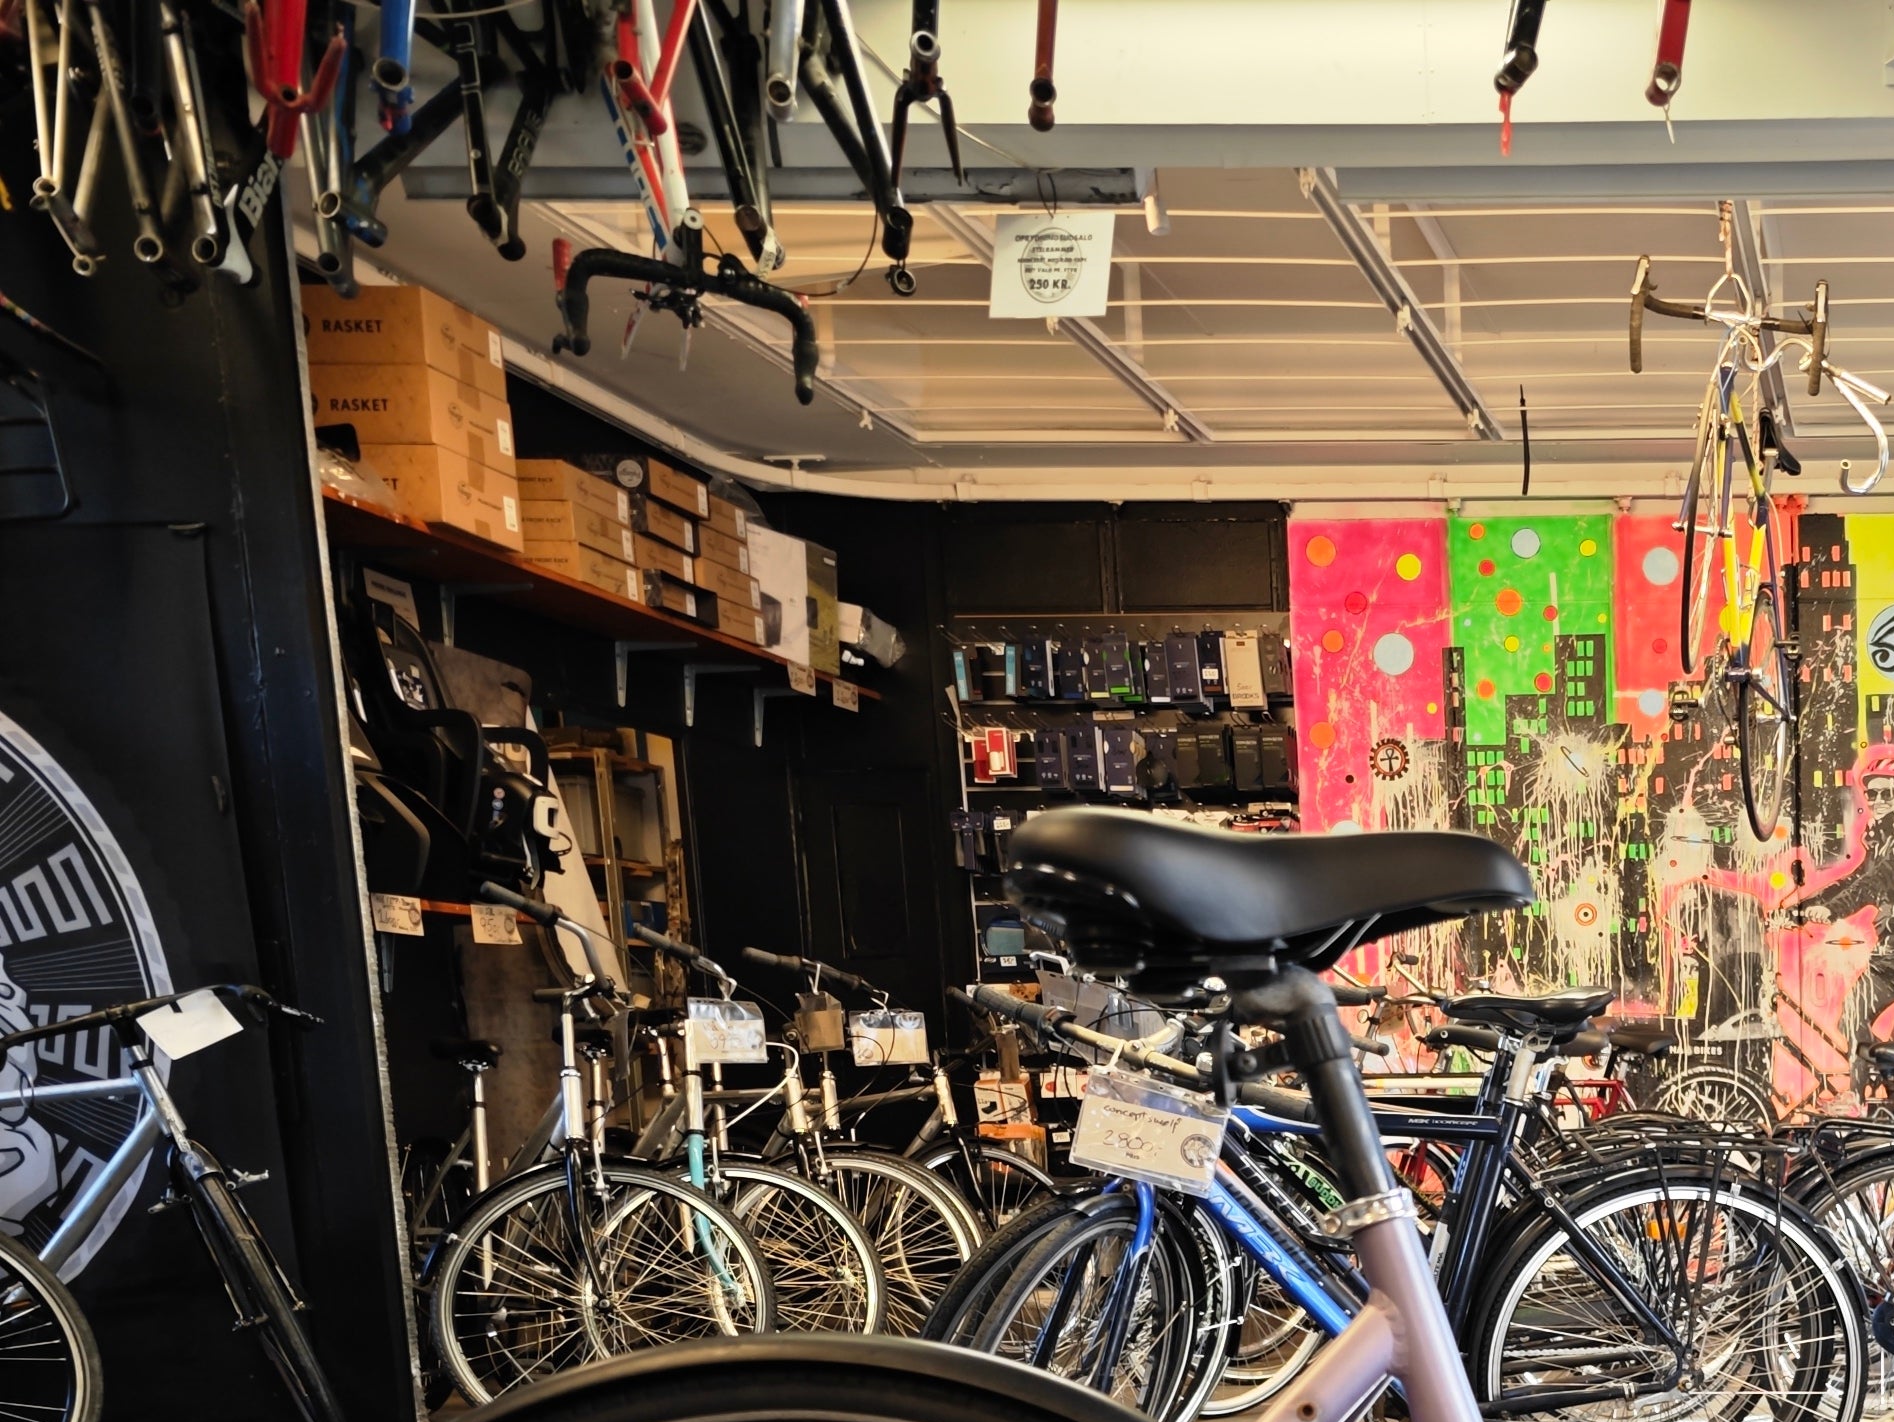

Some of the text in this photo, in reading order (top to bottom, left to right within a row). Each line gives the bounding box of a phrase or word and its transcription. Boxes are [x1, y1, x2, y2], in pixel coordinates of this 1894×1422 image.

[1029, 279, 1049, 290] 250
[1693, 1045, 1723, 1056] BIKES
[1306, 1176, 1342, 1211] BUDDH
